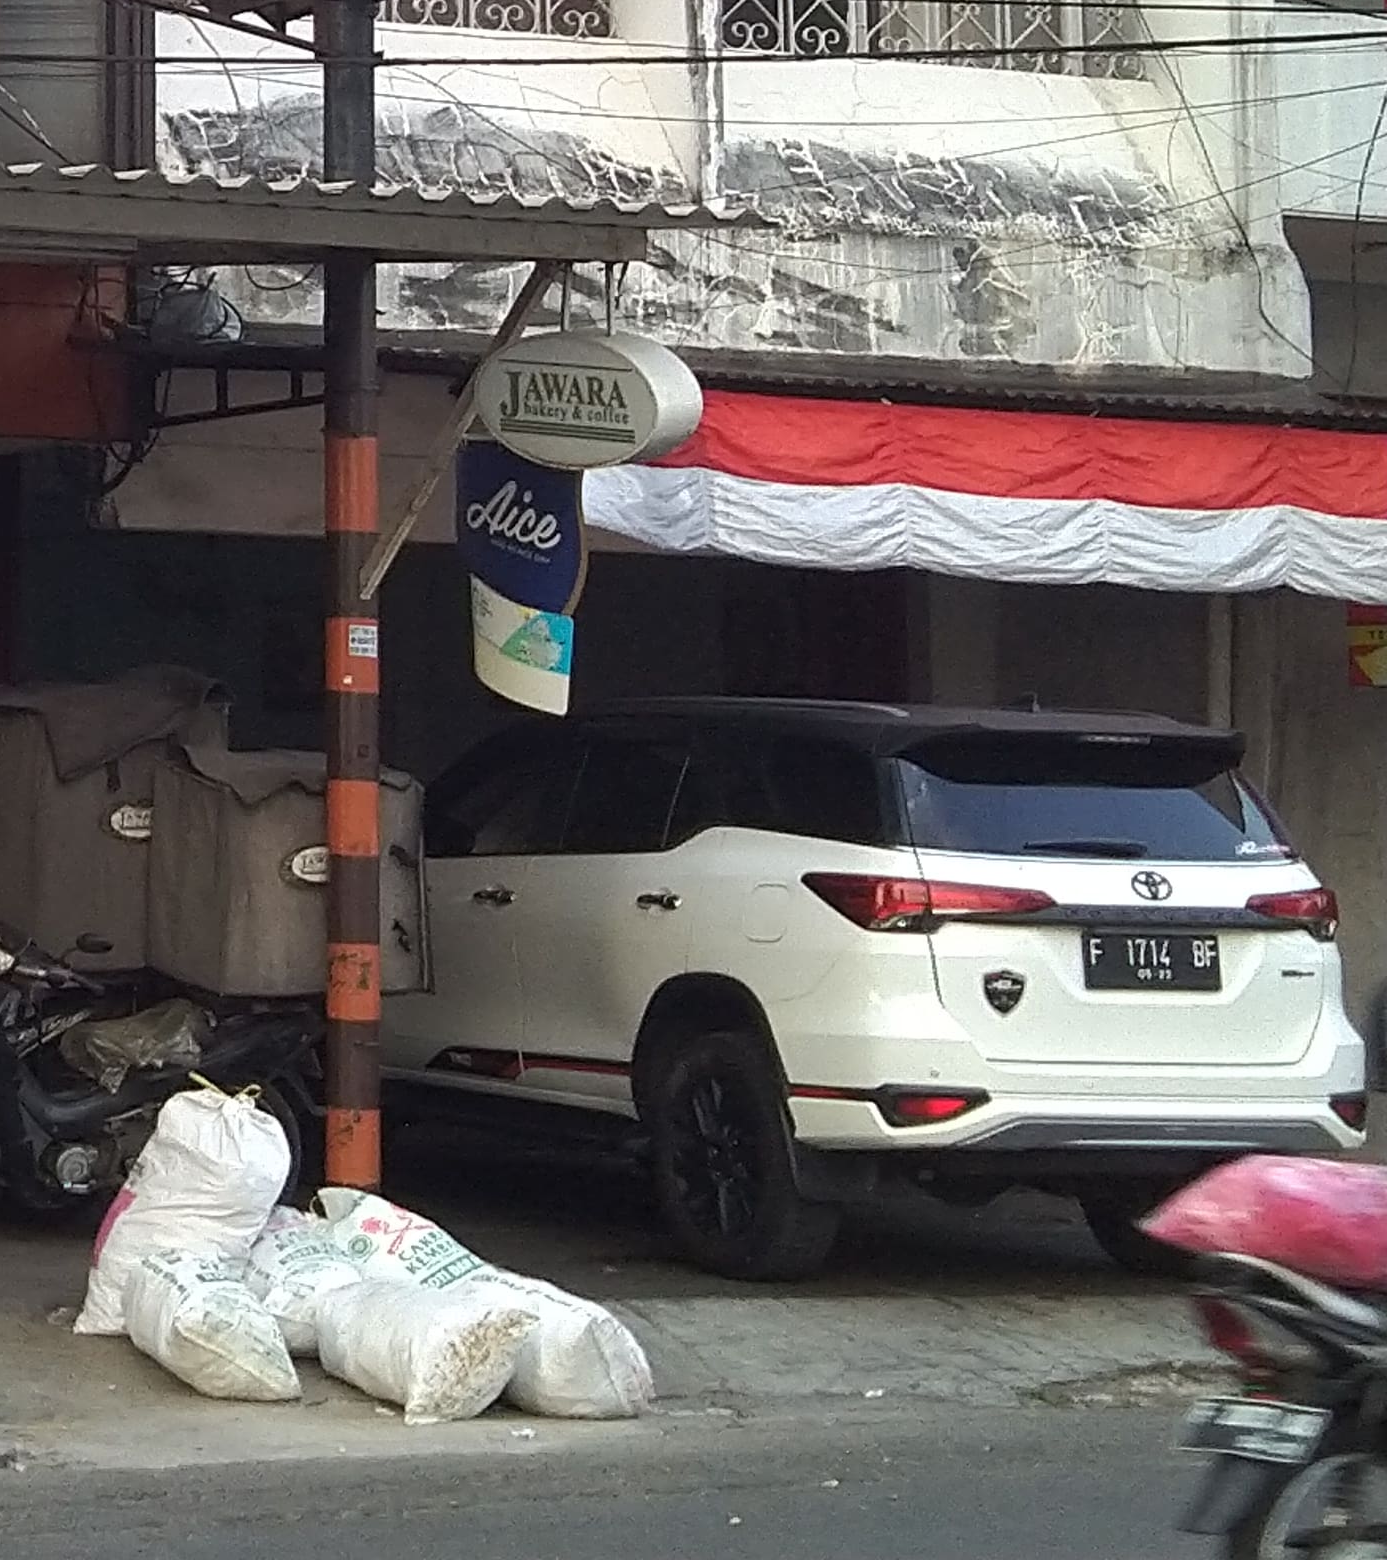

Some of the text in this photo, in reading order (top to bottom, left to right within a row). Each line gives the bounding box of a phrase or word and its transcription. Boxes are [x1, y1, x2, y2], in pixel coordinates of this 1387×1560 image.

[499, 371, 628, 418] JAWARA
[523, 401, 568, 422] bakery
[571, 405, 582, 421] &
[466, 479, 562, 549] Aice
[1088, 938, 1217, 969] F 1714 BF
